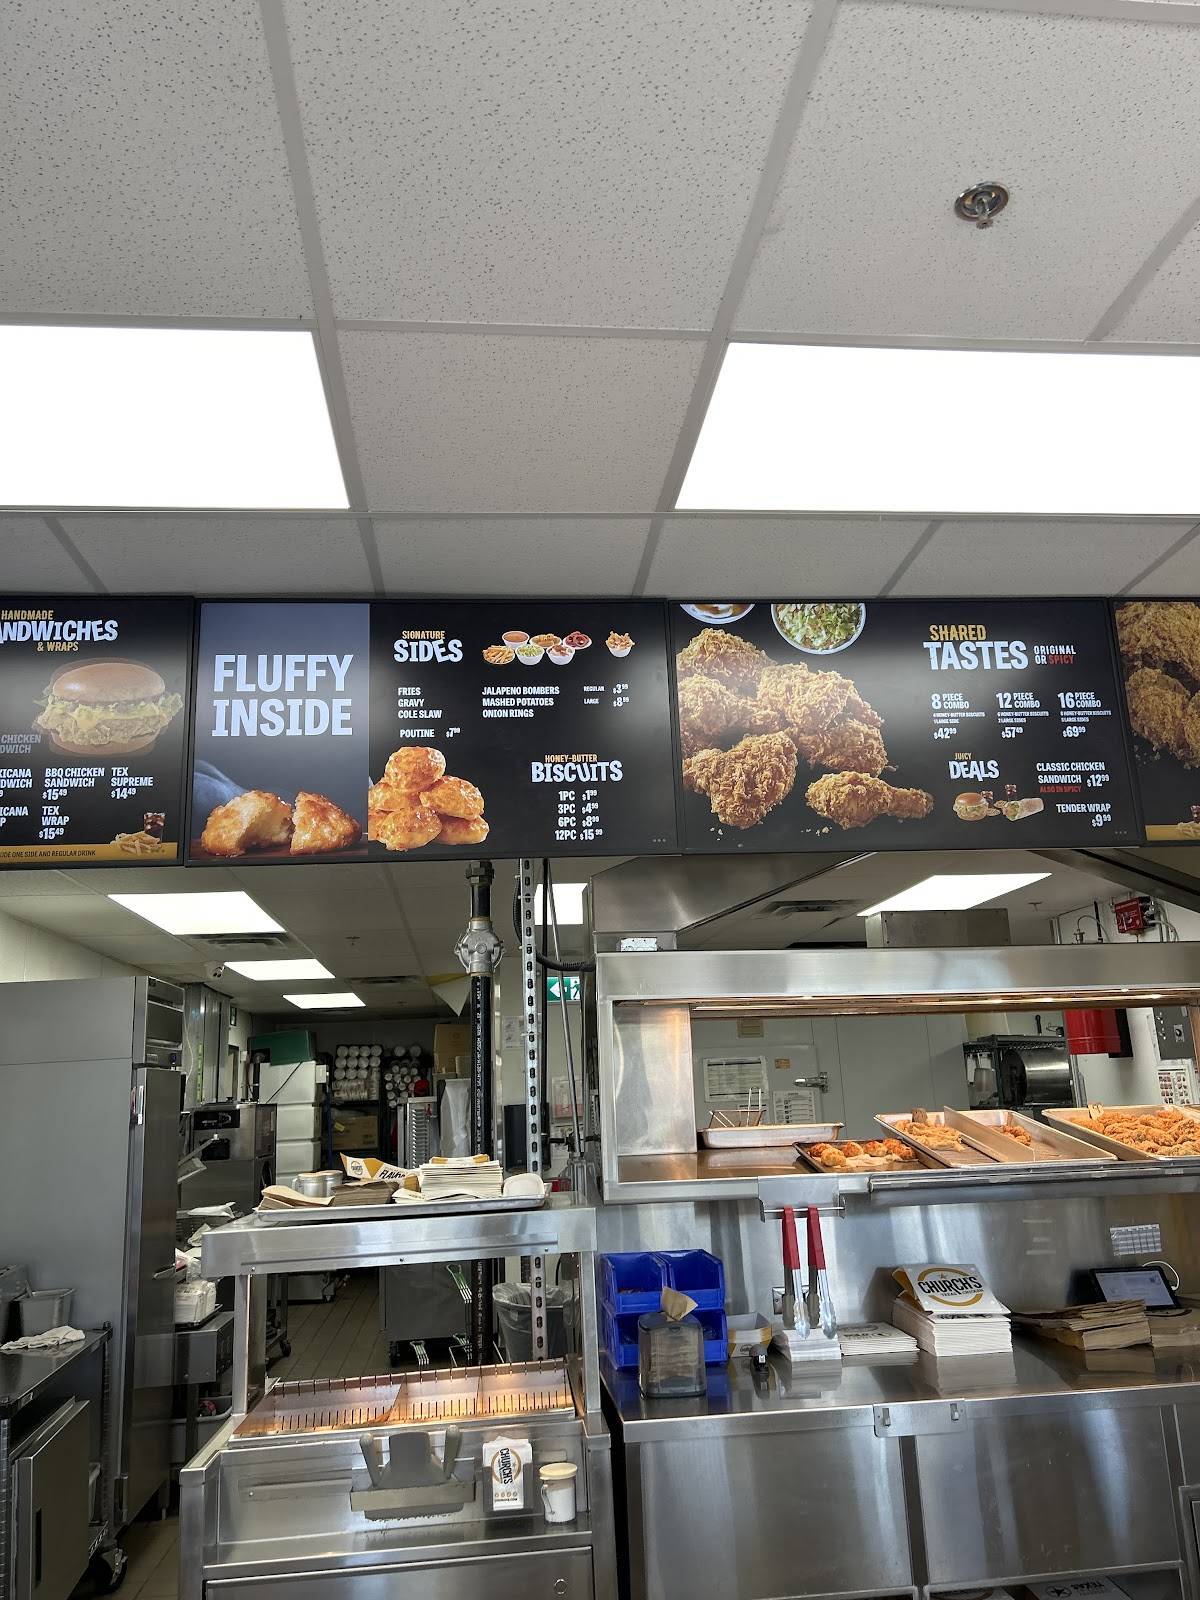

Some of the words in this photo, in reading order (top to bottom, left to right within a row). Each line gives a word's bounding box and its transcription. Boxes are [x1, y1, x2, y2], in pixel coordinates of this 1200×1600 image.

[1, 610, 54, 620] HANDMADE
[402, 631, 445, 639] SIGNATURE
[930, 624, 987, 641] SHARED
[37, 642, 44, 651] &
[47, 641, 79, 651] WRAPS
[393, 639, 463, 662] SIDES
[1034, 645, 1076, 654] ORIGINAL
[923, 640, 1029, 670] TASTES
[1035, 655, 1047, 664] OR
[1049, 655, 1074, 664] SPICY
[213, 654, 354, 692] FLUFFY
[398, 687, 421, 696] FRIES
[482, 686, 521, 695] JALAPENO
[523, 686, 560, 695] BOMBERS
[398, 699, 424, 707] GRAVY
[482, 698, 515, 706] MASHED
[517, 698, 554, 706] POTATOES
[931, 693, 941, 709] 8
[942, 693, 964, 701] PIECE
[996, 692, 1012, 708] 12
[1013, 692, 1034, 700] PIECE
[1014, 700, 1040, 708] COMBO
[1057, 692, 1075, 708] 16
[1075, 692, 1095, 700] PIECE
[1075, 699, 1101, 708] COMBO
[943, 701, 969, 709] COMBO
[211, 698, 353, 737] INSIDE
[398, 710, 418, 719] COLE
[419, 710, 442, 718] SLAW
[482, 709, 508, 718] ONION
[509, 709, 534, 717] RINGS
[400, 729, 435, 738] POUTINE
[1, 734, 41, 743] CHICKEN
[545, 754, 598, 762] HONEY-BUTTER
[955, 752, 972, 760] JUICY
[949, 760, 1000, 781] DEALS
[1036, 762, 1070, 771] CLASSIC
[1070, 762, 1105, 771] CHICKEN
[45, 768, 63, 779] BBQ
[65, 768, 105, 777] CHICKEN
[111, 767, 128, 776] TEX
[531, 760, 623, 783] BISCUITS
[45, 778, 95, 788] SANDWICH
[111, 777, 154, 786] SUPREME
[1038, 774, 1082, 783] SANDWICH
[1, 779, 33, 788] DWICH
[558, 790, 575, 801] 1PC
[42, 806, 60, 815] TEX
[558, 804, 576, 814] 3PC
[1056, 804, 1087, 813] TENDER
[1087, 803, 1111, 812] WRAP
[41, 816, 70, 826] WRAP
[558, 816, 576, 827] 6PC
[554, 830, 577, 840] 12PC
